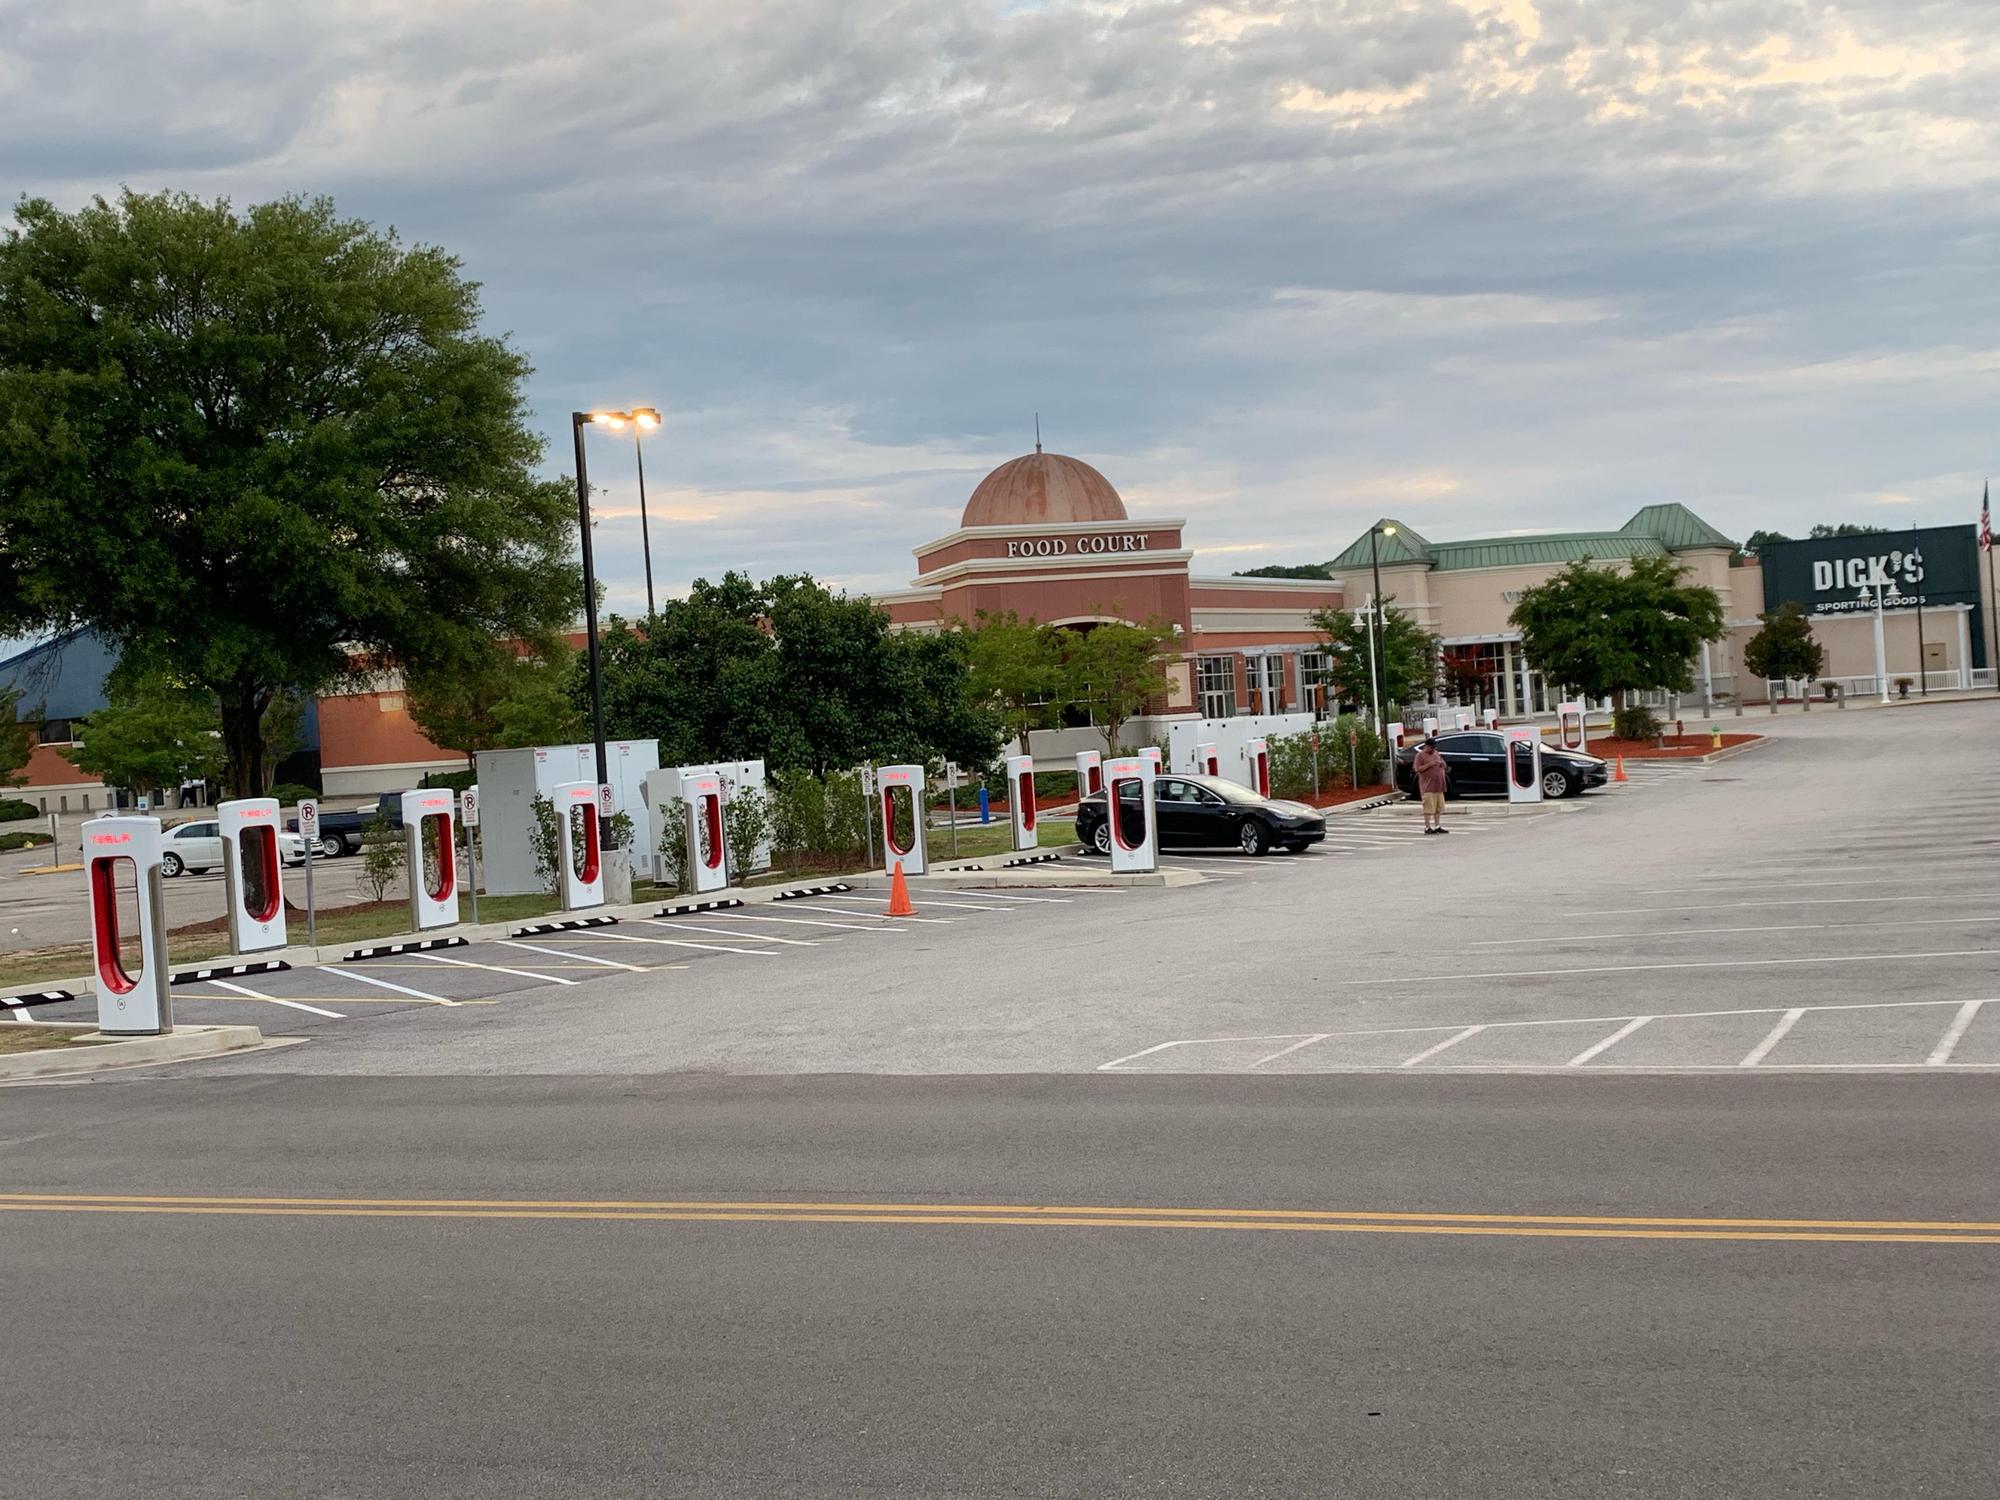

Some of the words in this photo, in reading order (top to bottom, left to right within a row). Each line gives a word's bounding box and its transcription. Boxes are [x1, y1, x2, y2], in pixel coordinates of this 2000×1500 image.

[1007, 539, 1067, 557] FOOD
[1077, 534, 1148, 554] COURT
[1814, 550, 1925, 591] DICK'S
[1816, 599, 1879, 611] SPORTING
[1883, 596, 1926, 606] GOODS
